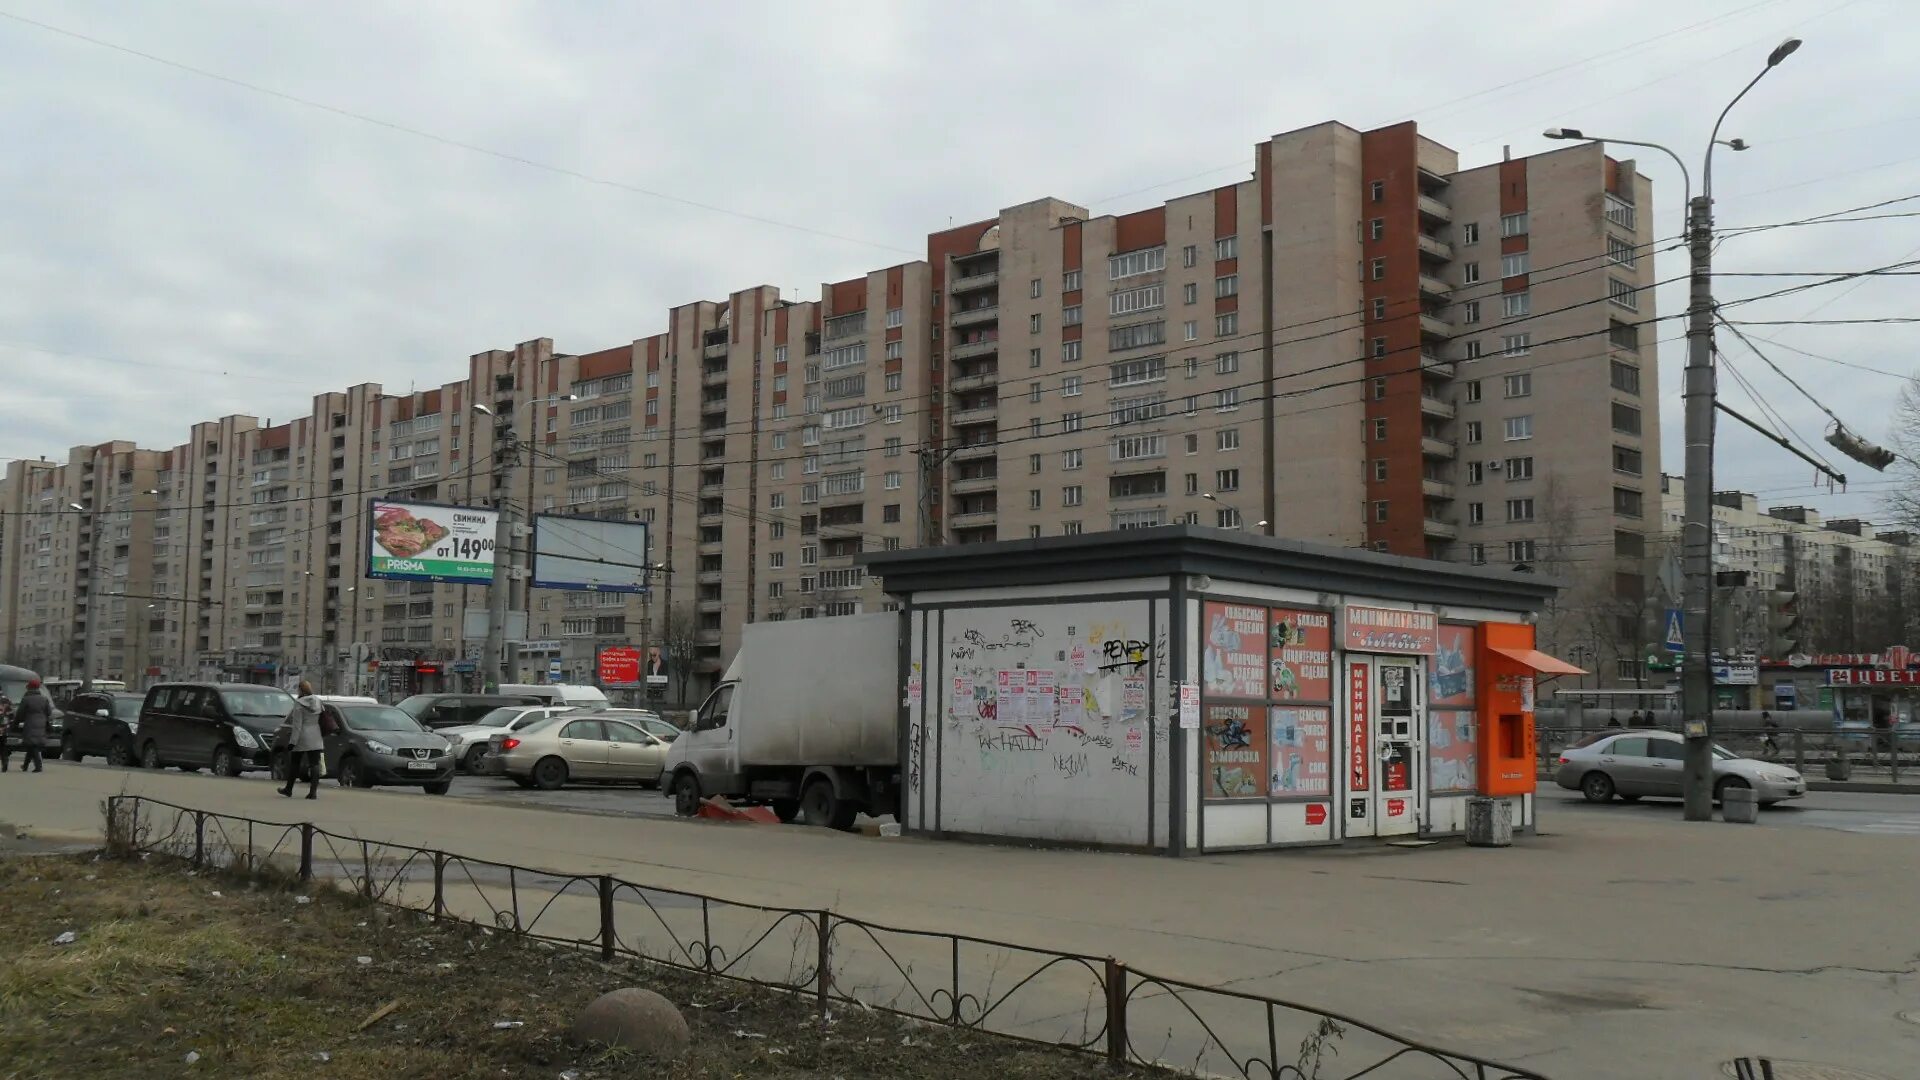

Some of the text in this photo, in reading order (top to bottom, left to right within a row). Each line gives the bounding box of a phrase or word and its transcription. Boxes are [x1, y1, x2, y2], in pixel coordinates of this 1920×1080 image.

[453, 513, 486, 524] СВИНИНА
[387, 559, 424, 572] PRISMA
[1350, 608, 1433, 630] МИНИМАГАЗИН
[1832, 671, 1849, 680] 24
